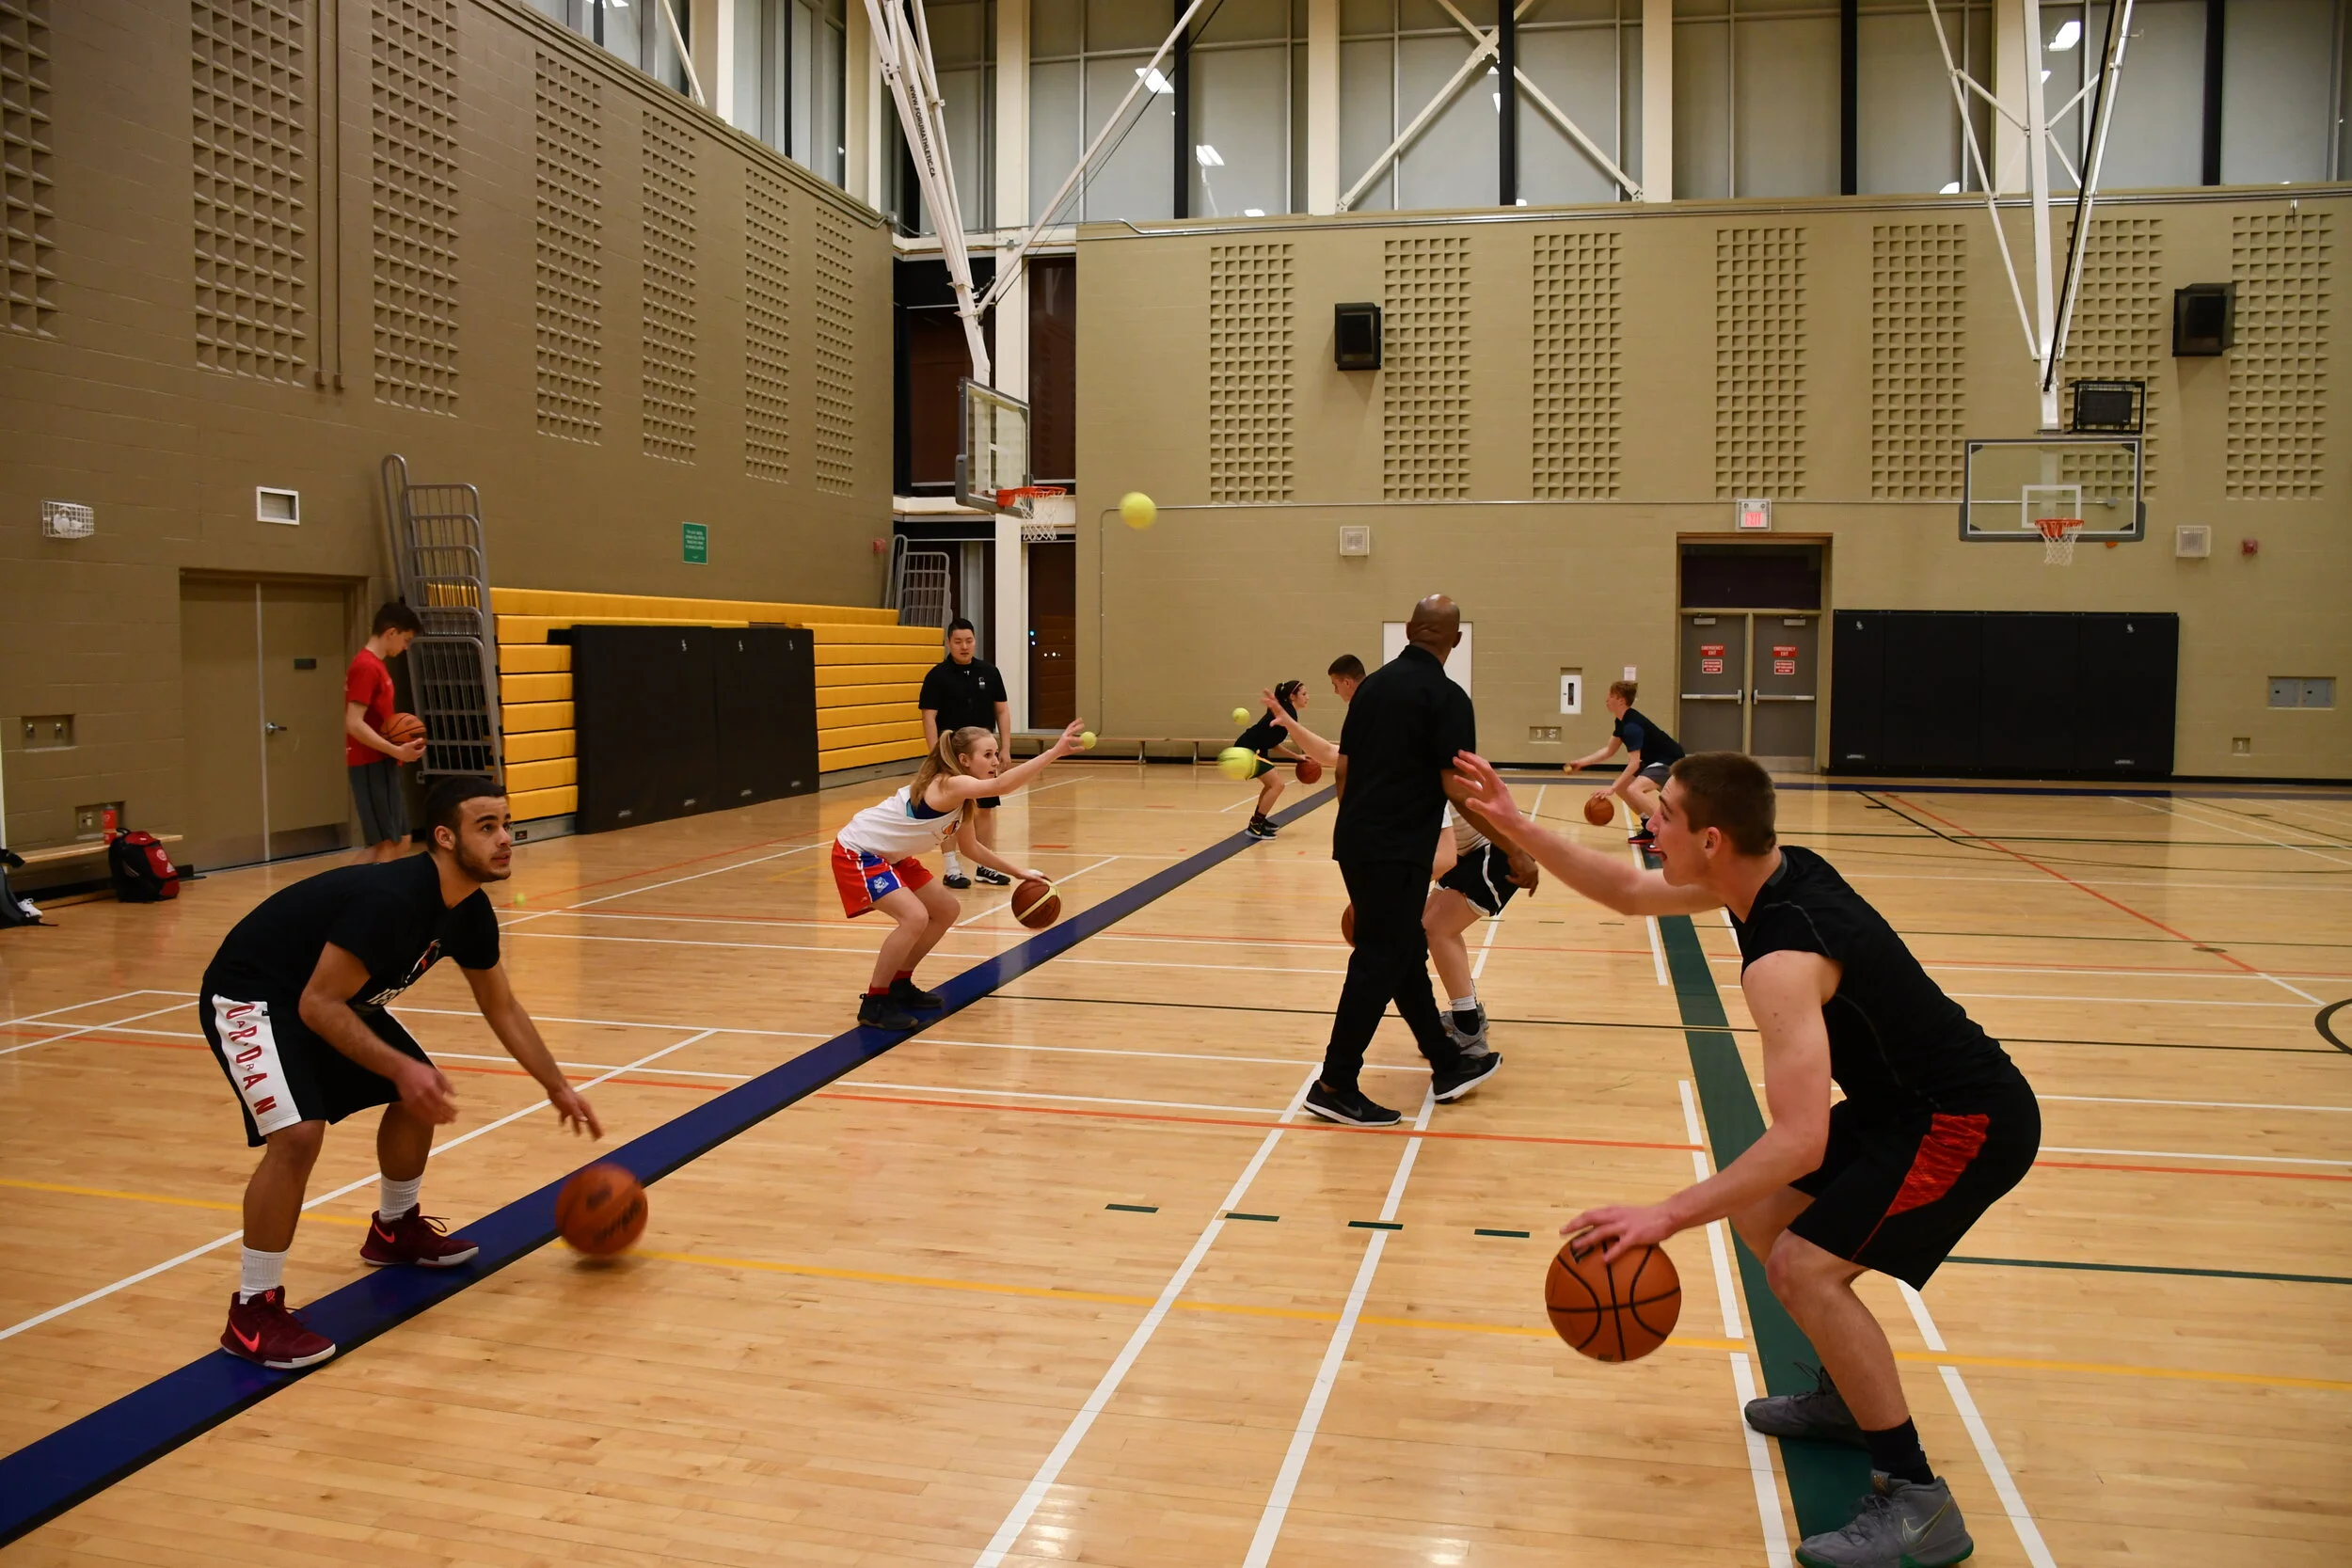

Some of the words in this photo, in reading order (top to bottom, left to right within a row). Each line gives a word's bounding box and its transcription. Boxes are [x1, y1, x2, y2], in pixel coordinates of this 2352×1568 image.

[909, 84, 936, 178] WWW.FORUMATHLETIC.CA
[1745, 512, 1762, 526] EXIT
[226, 1005, 277, 1116] ORDAN
